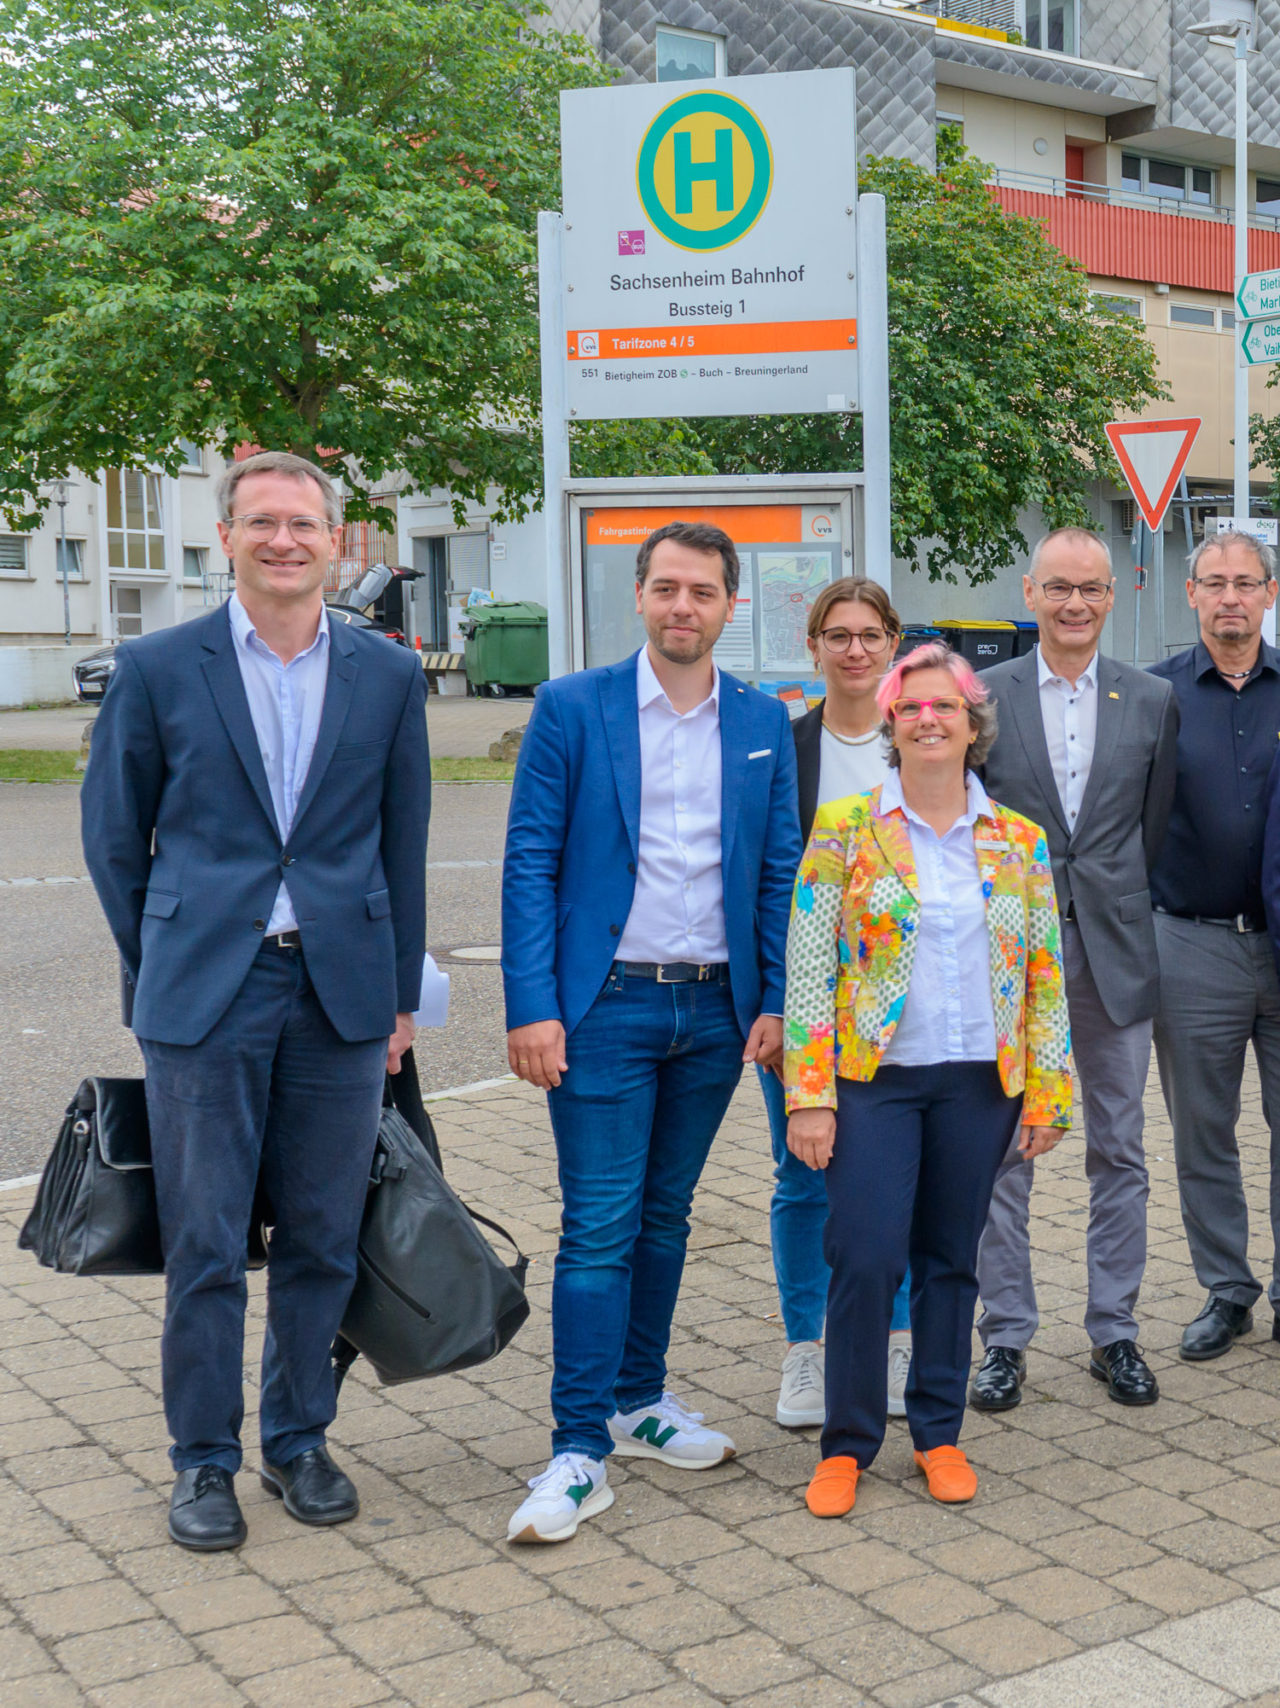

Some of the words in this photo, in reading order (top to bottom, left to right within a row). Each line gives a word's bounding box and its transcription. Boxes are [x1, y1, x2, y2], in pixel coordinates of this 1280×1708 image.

[673, 128, 734, 214] H
[610, 269, 725, 291] Sachsenheim
[731, 264, 805, 285] Bahnhof
[669, 299, 733, 318] Bussteig
[739, 299, 745, 313] 1
[612, 337, 667, 350] Tarifzone
[670, 336, 677, 348] 4
[687, 335, 695, 348] 5
[581, 368, 598, 378] 551
[604, 370, 655, 382] Bietigheim
[657, 369, 678, 379] ZOB
[699, 367, 723, 378] Buch
[734, 364, 808, 377] Breuningerland
[598, 526, 656, 538] Fahrgastinfor
